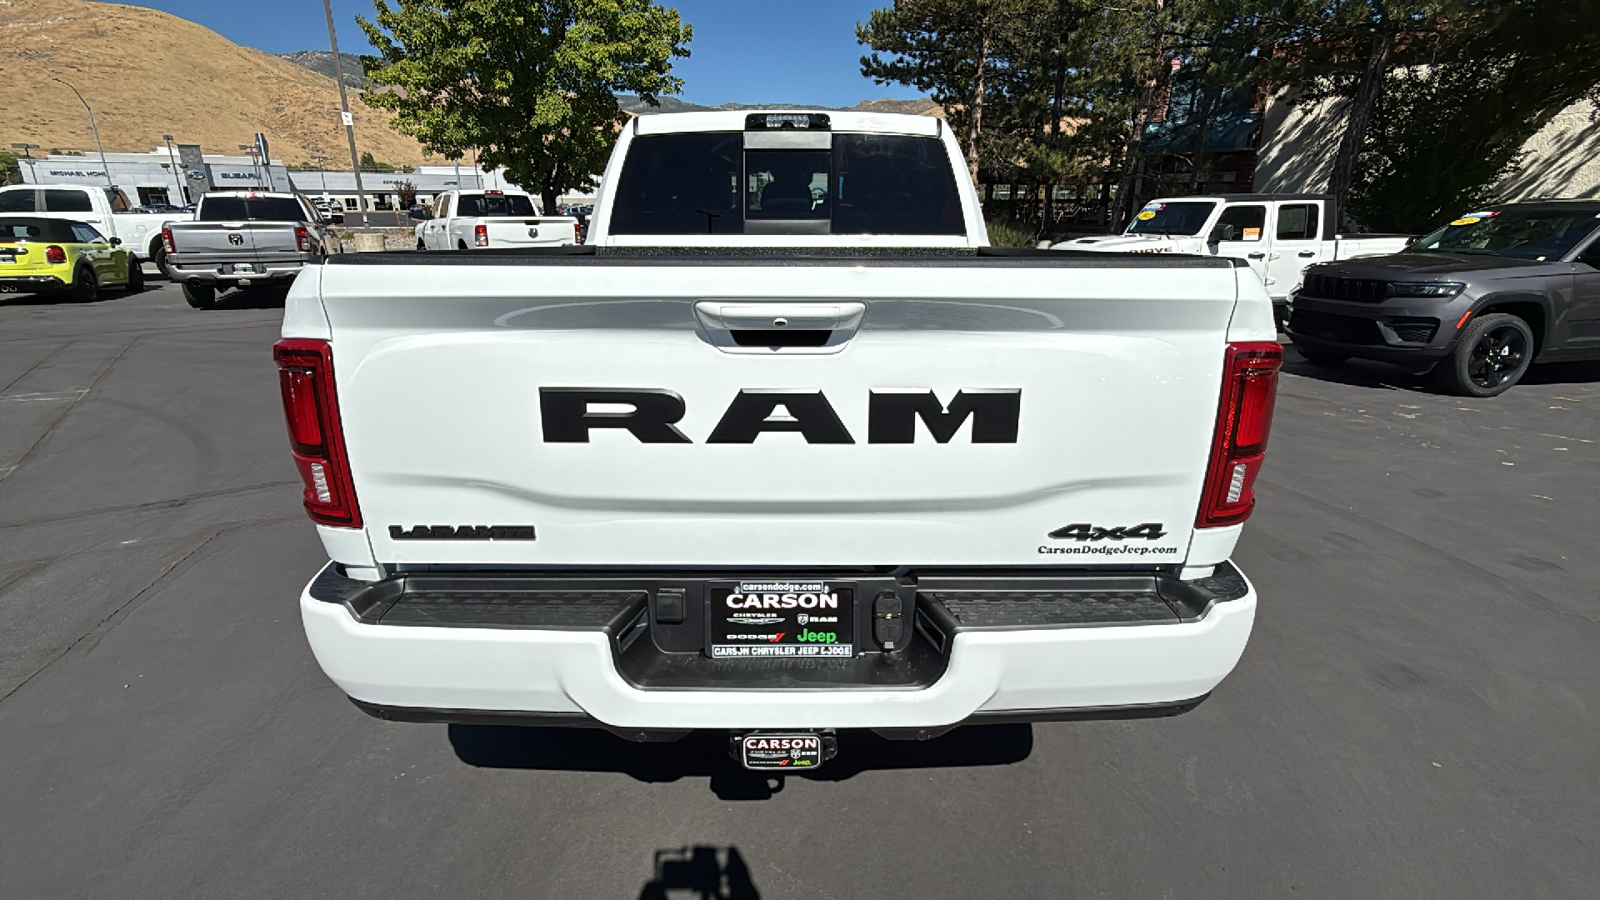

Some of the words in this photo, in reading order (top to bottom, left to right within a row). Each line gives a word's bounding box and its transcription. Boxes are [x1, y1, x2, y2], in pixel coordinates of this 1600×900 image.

[539, 387, 1021, 444] RAM
[388, 524, 537, 542] LARAMIE
[1047, 522, 1168, 542] 4x4
[1037, 545, 1178, 556] CarsonDodgeJeep.com
[743, 583, 821, 592] carsondodge.com
[726, 593, 838, 609] CARSON
[797, 628, 838, 644] Jeep
[751, 646, 796, 656] CHRYSLER
[797, 646, 819, 655] JEEP
[746, 739, 817, 749] CARSON
